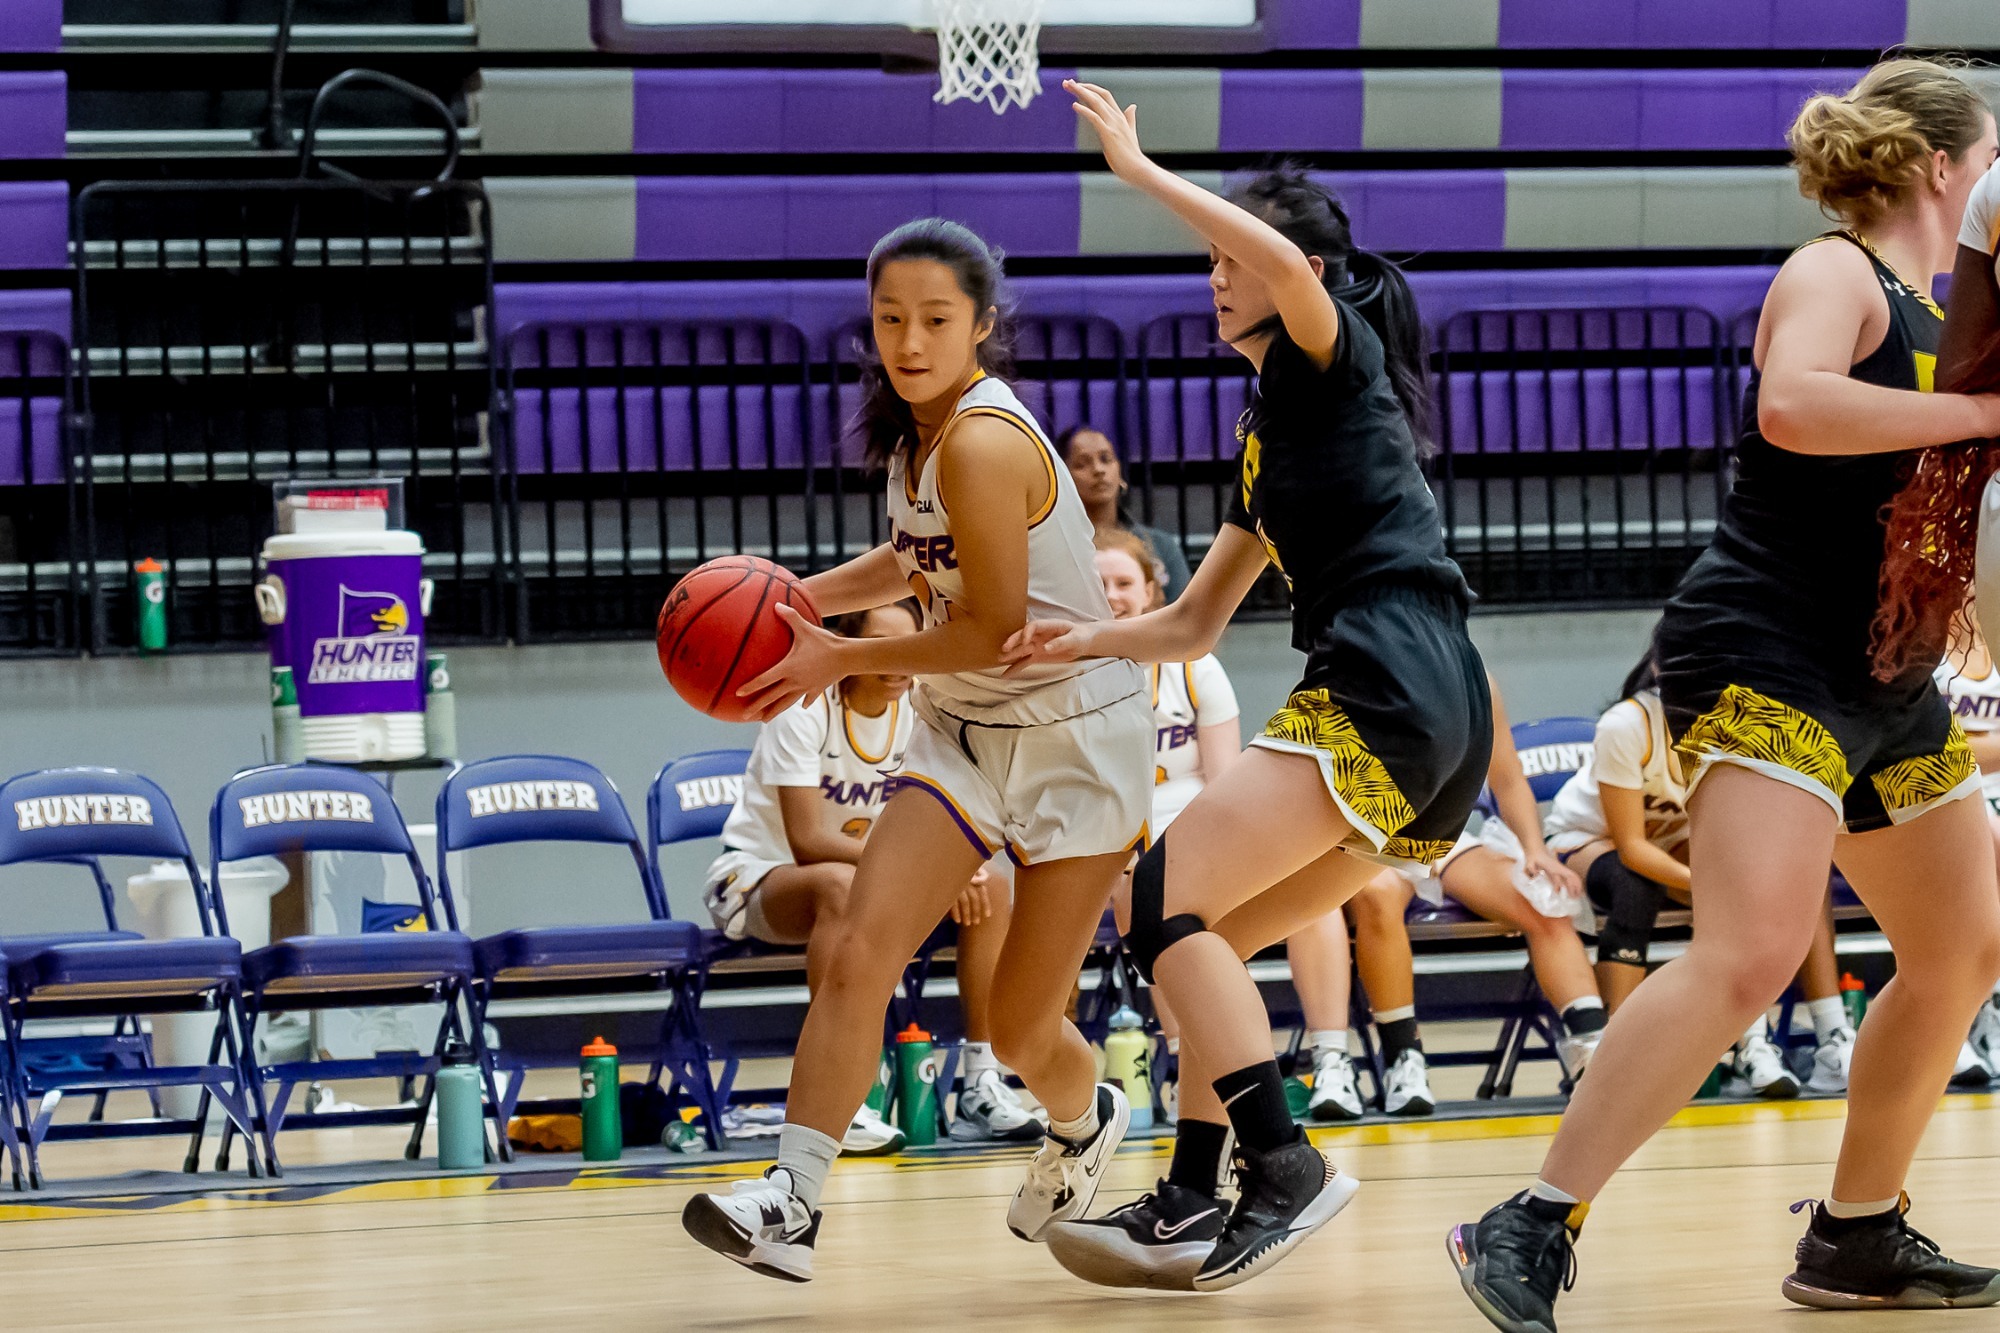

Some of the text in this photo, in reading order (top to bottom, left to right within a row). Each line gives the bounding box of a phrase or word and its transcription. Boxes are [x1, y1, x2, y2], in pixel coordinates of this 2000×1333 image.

[318, 641, 415, 665] HUNTER
[1942, 694, 2000, 718] UNT
[239, 790, 374, 828] HUNTER
[466, 780, 600, 818] HUNTER
[675, 775, 745, 811] HUN
[14, 794, 154, 832] HUNTER
